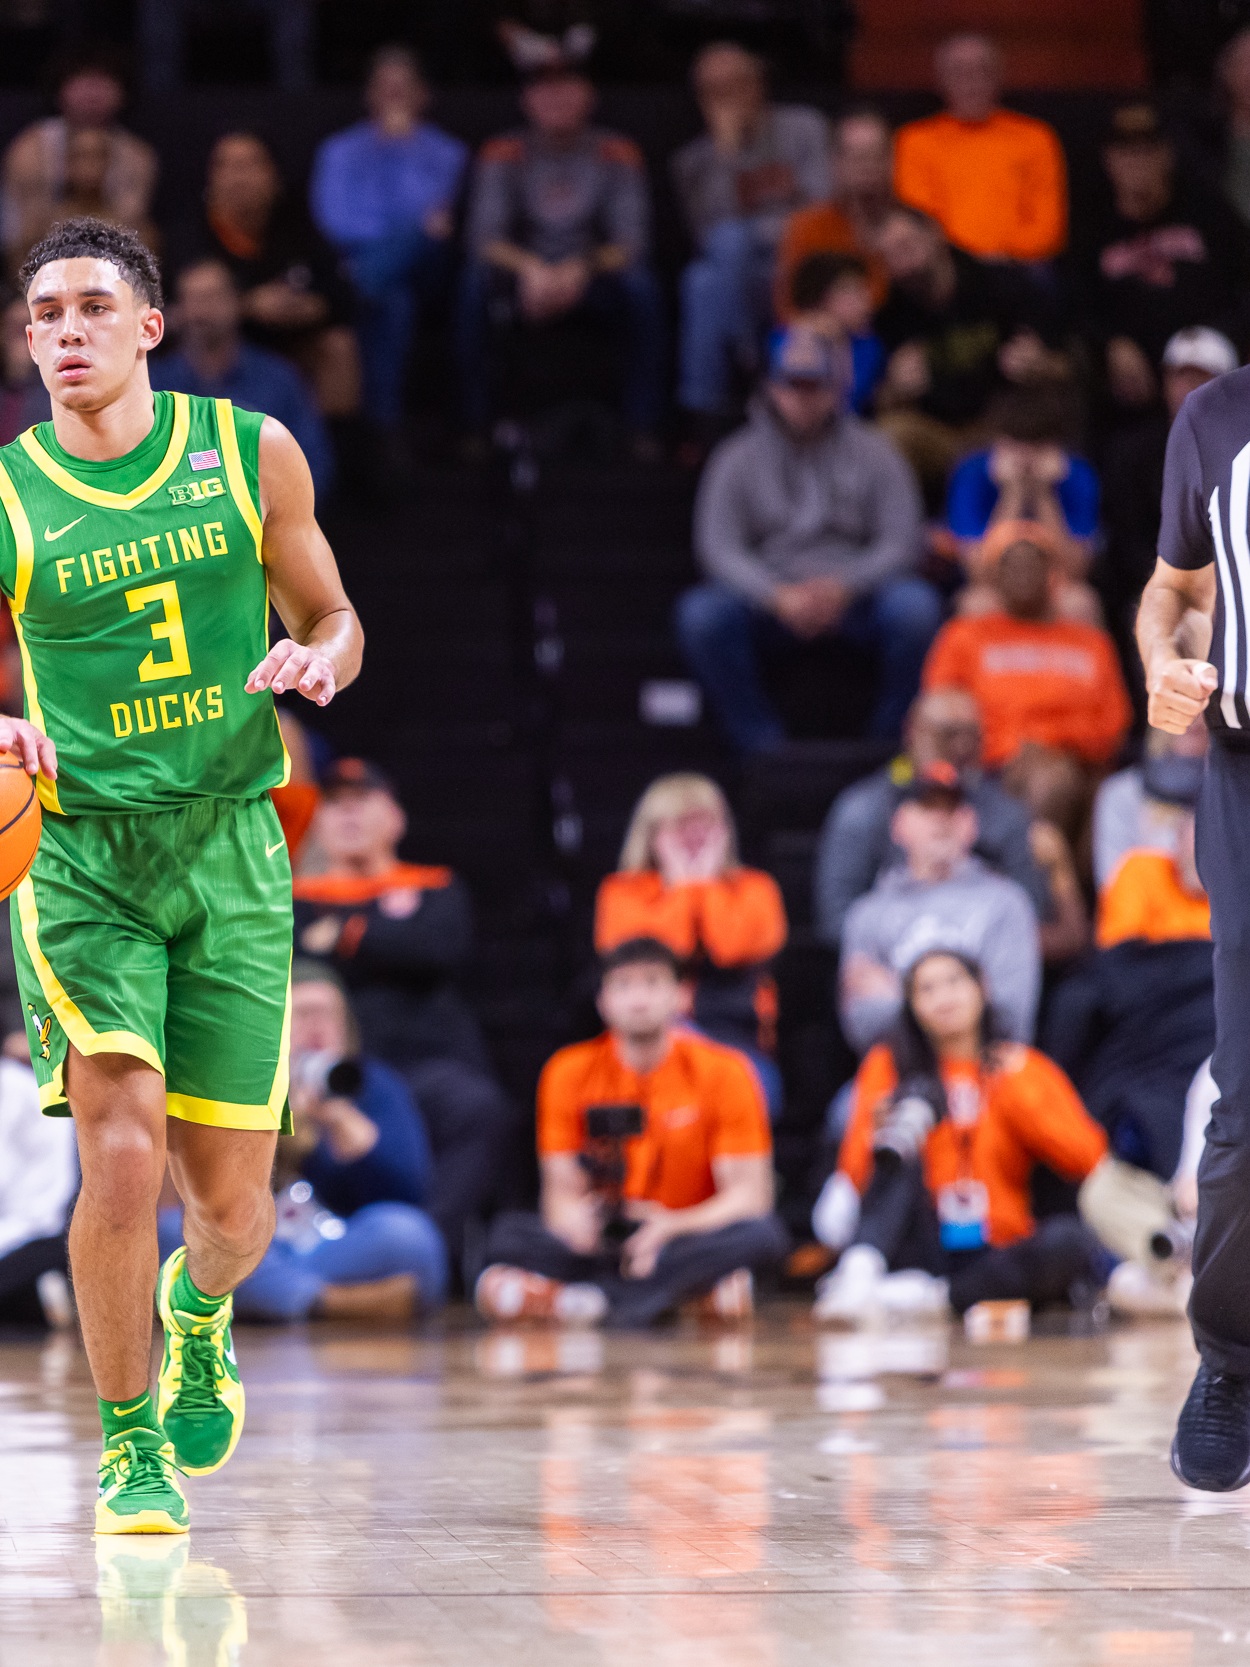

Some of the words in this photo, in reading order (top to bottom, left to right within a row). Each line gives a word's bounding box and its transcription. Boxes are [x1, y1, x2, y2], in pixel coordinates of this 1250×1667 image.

[55, 521, 228, 594] FIGHTING
[124, 580, 192, 683] 3
[110, 684, 224, 738] DUCKS
